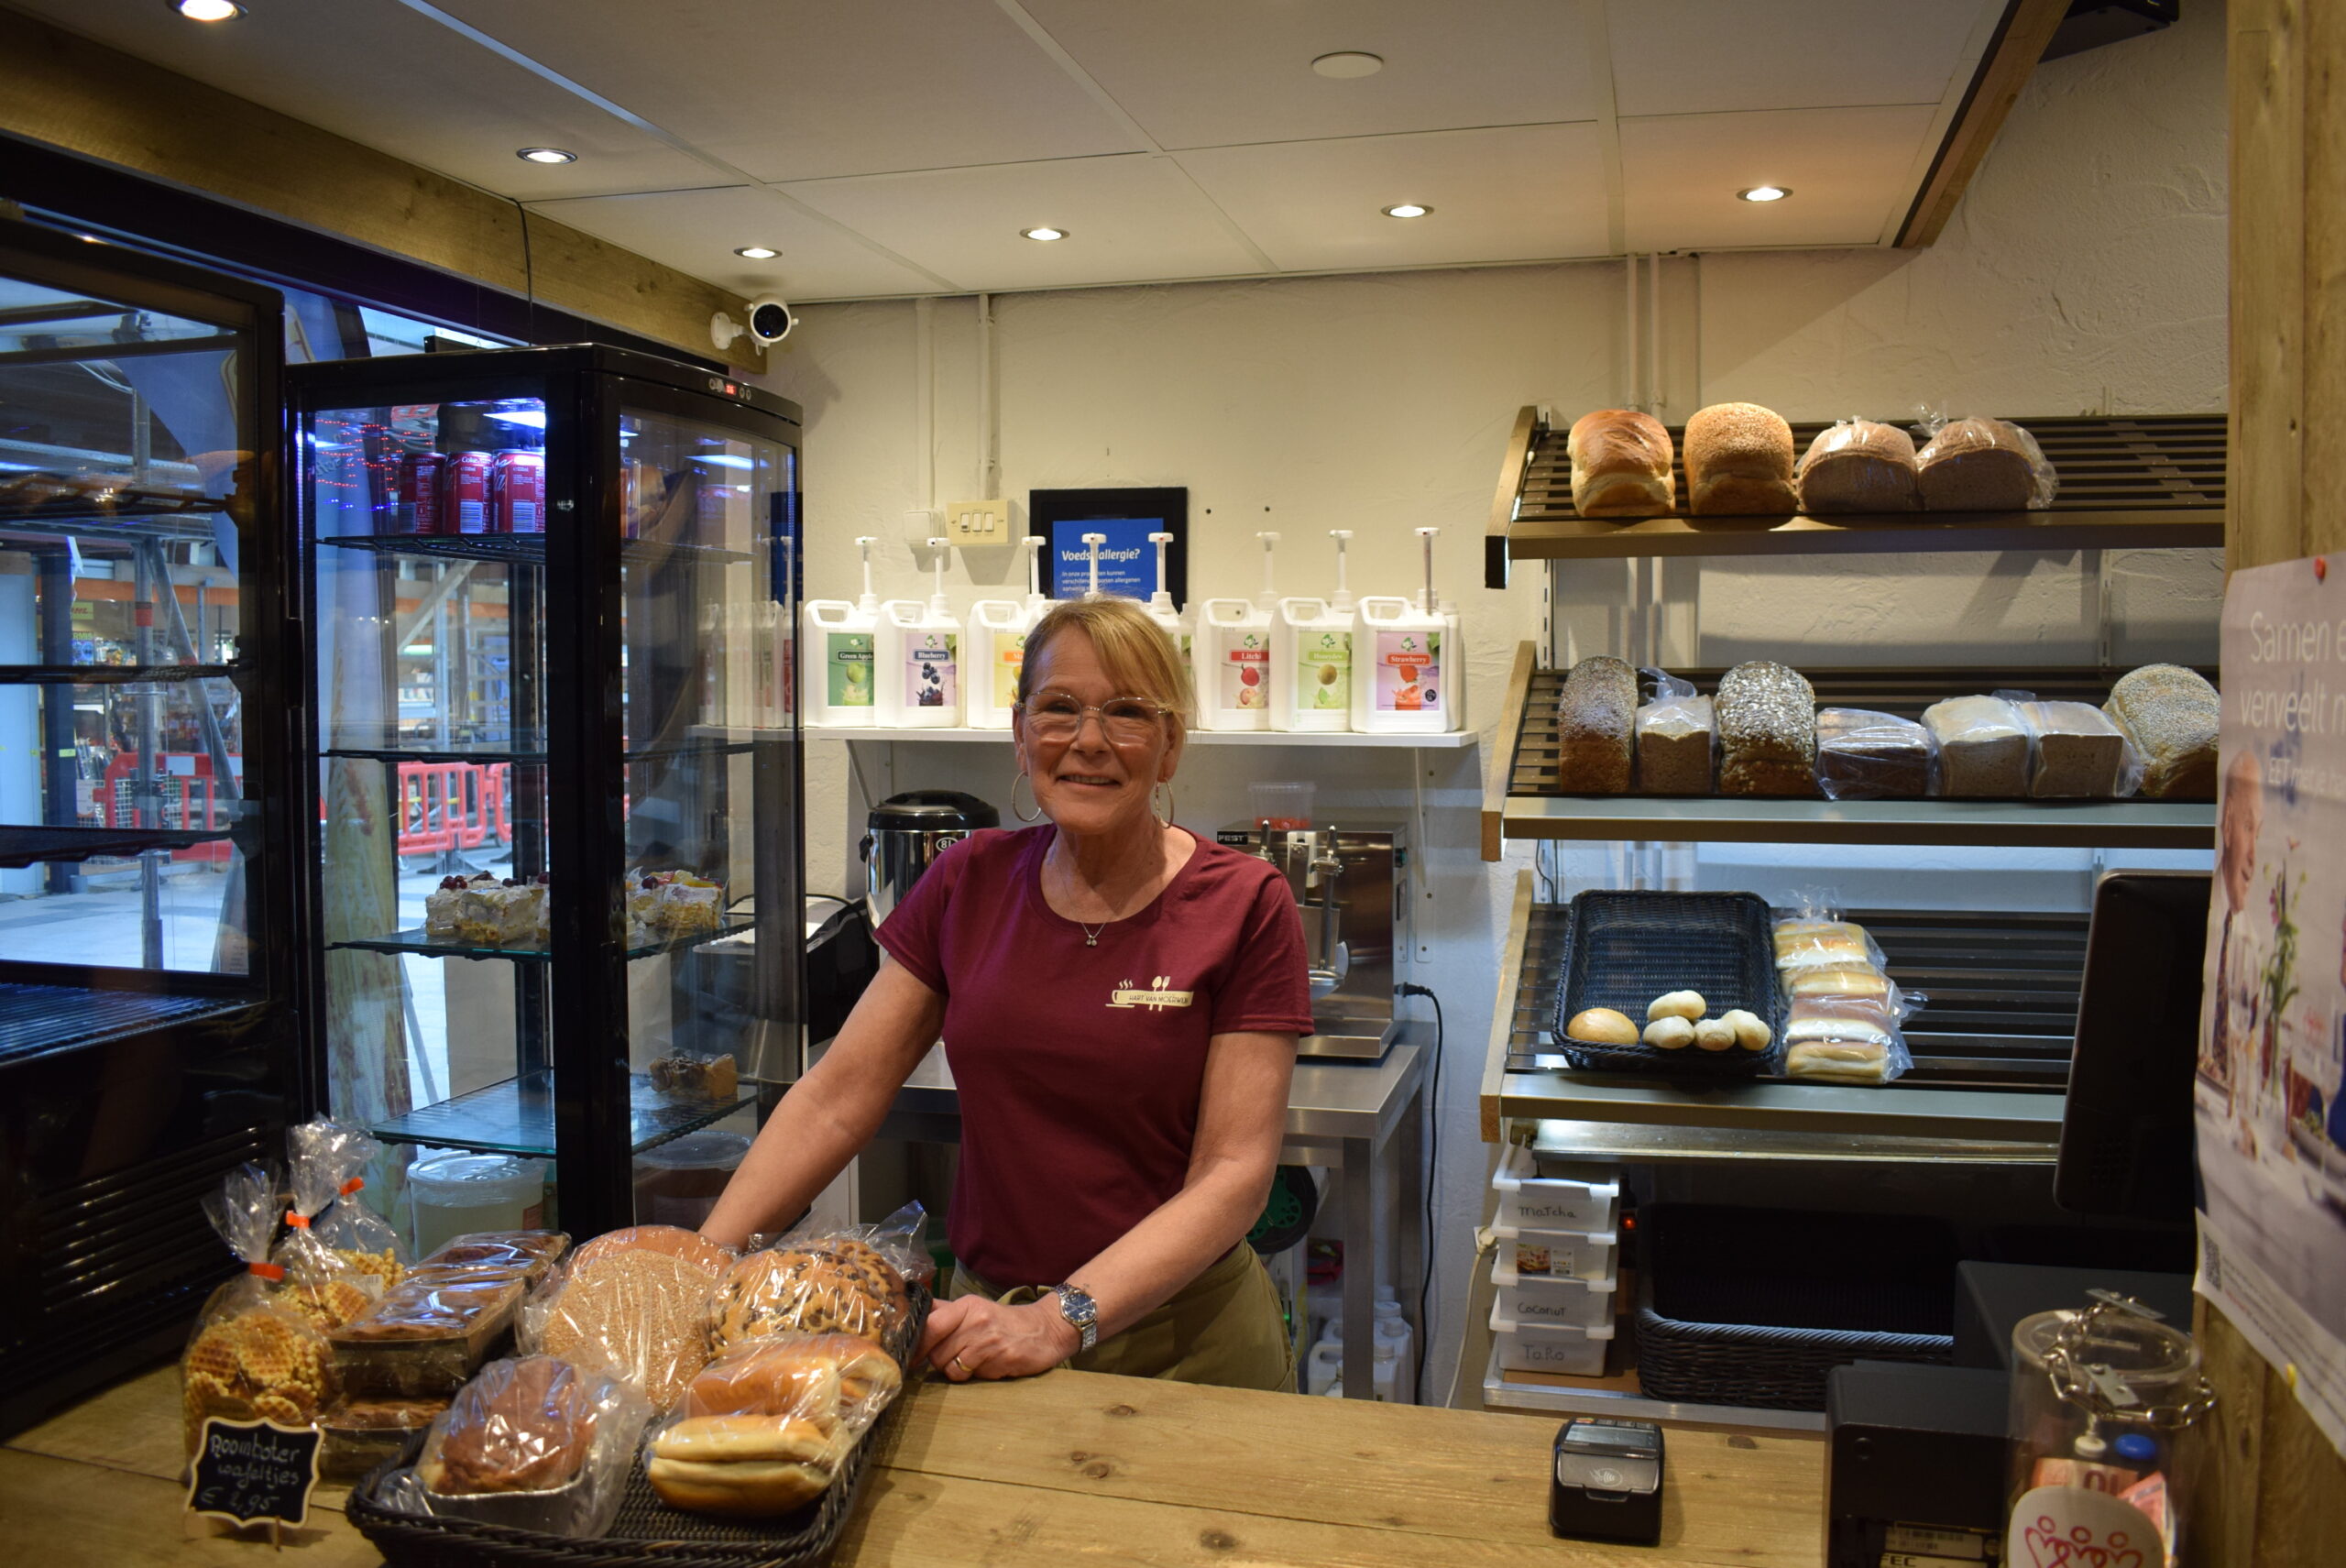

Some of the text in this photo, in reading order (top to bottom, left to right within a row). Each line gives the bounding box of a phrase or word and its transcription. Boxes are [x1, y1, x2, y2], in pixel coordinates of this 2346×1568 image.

[1061, 548, 1140, 562] Voedsallergie?
[2250, 610, 2330, 663] Samen
[839, 652, 857, 660] Green
[917, 651, 946, 661] Blueberry
[1241, 652, 1262, 660] Litchi
[1390, 655, 1427, 664] Strawberry
[2240, 677, 2328, 734] verveelt
